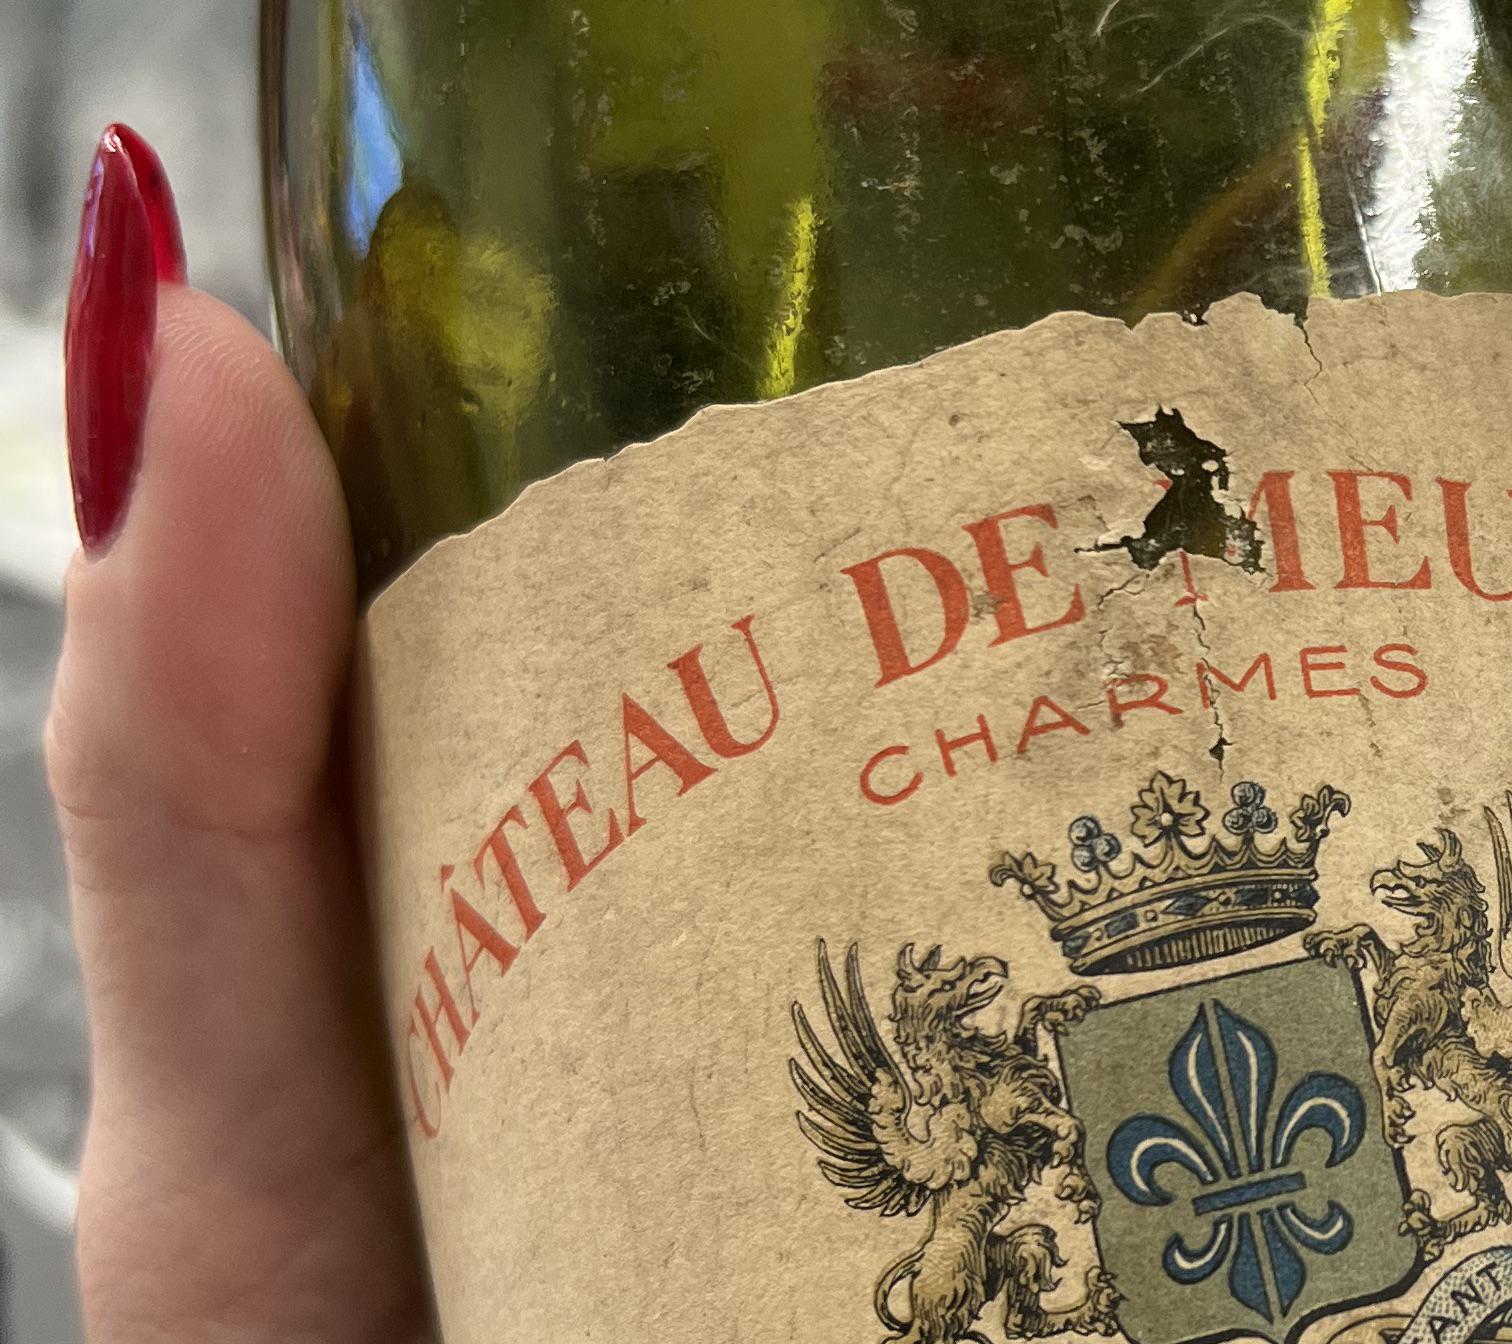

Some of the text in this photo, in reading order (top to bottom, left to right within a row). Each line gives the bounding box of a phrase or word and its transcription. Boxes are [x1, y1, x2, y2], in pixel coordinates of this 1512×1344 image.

[408, 614, 781, 1139] CHÂTEAU
[841, 503, 1086, 689] DE
[859, 642, 1429, 806] CHARMES
